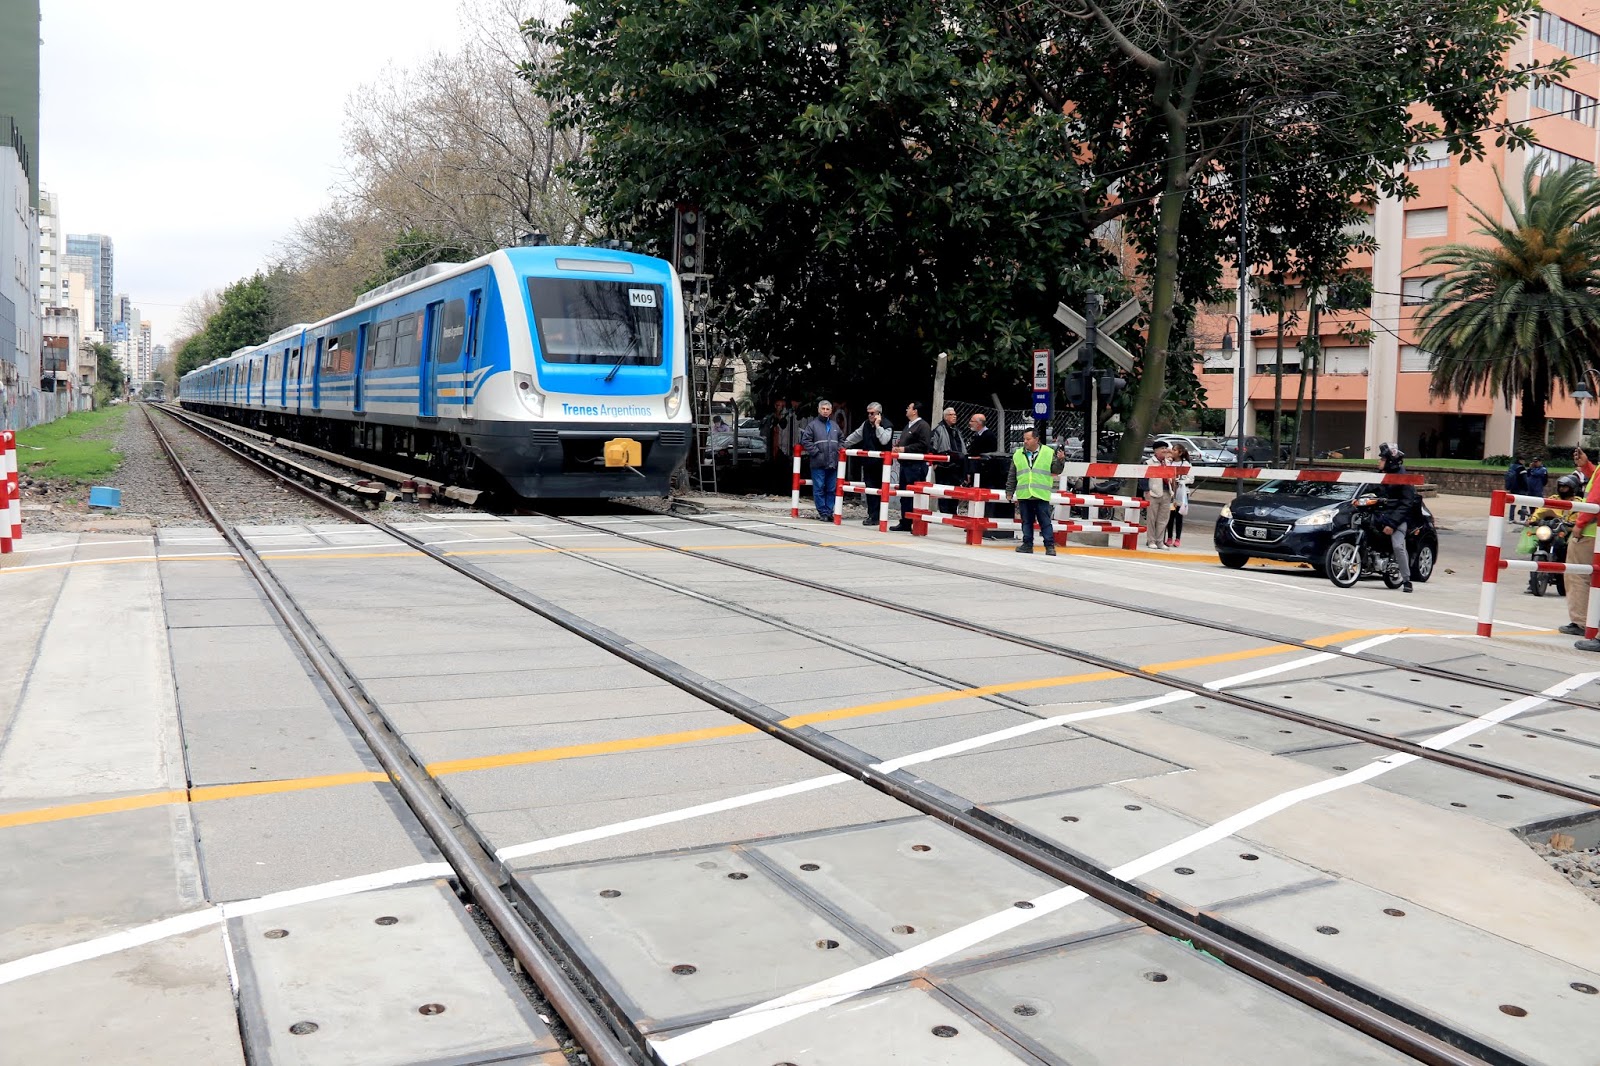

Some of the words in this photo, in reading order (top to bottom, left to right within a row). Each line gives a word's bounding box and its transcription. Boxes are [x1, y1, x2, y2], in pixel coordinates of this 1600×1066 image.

[632, 293, 653, 304] M09
[562, 403, 599, 416] Trenes
[600, 404, 652, 418] Argentinos
